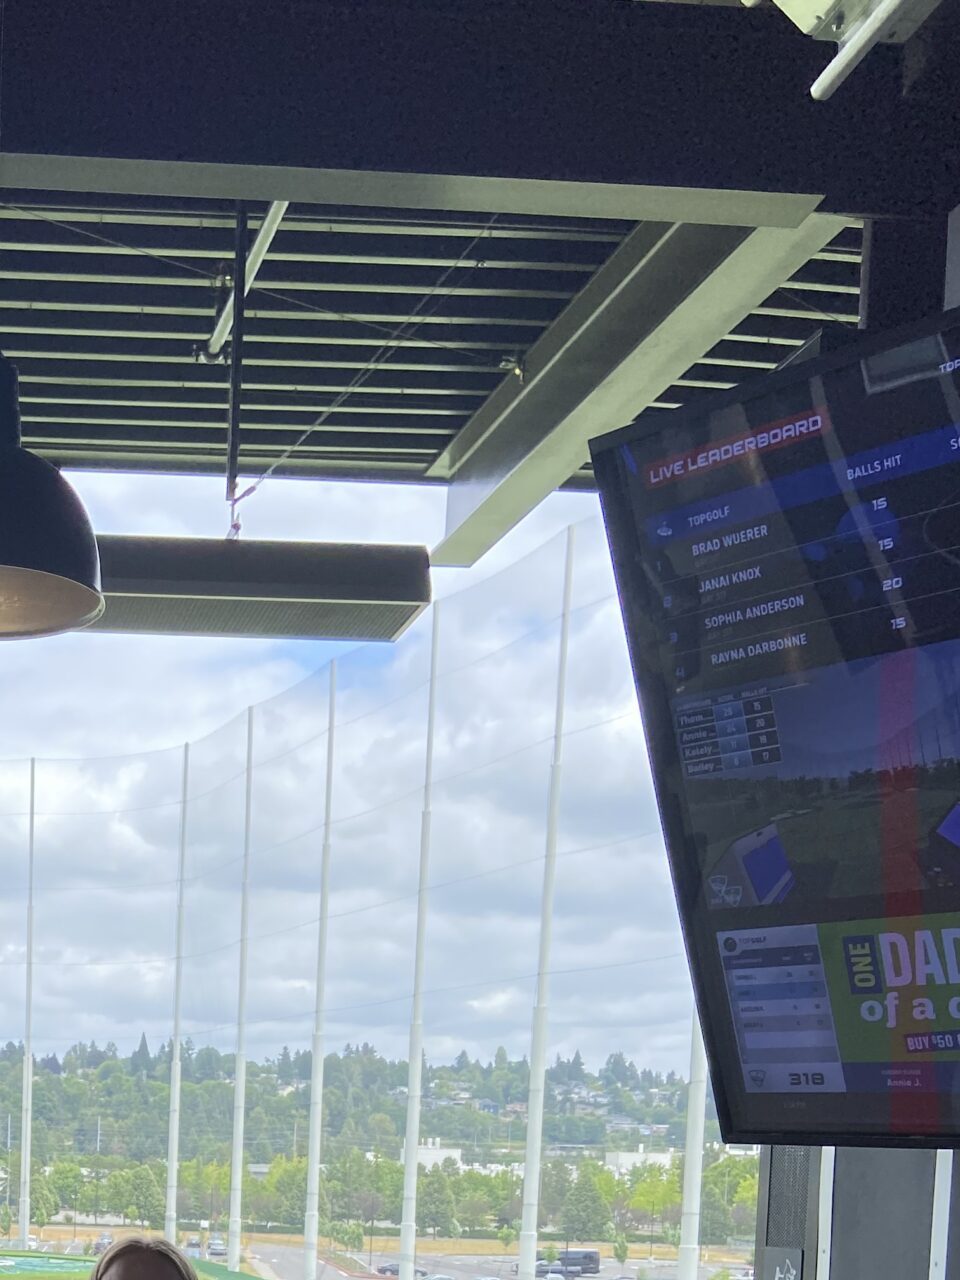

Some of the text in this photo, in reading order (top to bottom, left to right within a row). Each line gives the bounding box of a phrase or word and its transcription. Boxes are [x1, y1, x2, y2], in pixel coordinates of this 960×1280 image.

[650, 415, 822, 484] LIVE LEADERBOARD
[846, 454, 902, 480] BALLS HIT
[688, 505, 730, 528] TOPGOLF
[872, 497, 888, 511] 15
[692, 538, 721, 556] BRAD
[722, 524, 768, 548] WUERER
[878, 537, 894, 551] 15
[698, 575, 730, 593] JANAI
[732, 565, 762, 584] KNOX
[882, 577, 903, 592] 20
[704, 610, 744, 629] SOPHIA
[746, 594, 805, 619] ANDERSON
[890, 616, 907, 631] 15
[711, 648, 746, 665] RAYNA
[748, 633, 808, 657] DARBONNE
[848, 942, 876, 988] ONE
[860, 991, 899, 1028] of
[912, 998, 936, 1020] a
[906, 1035, 930, 1051] BUY
[931, 1033, 953, 1049] $50
[789, 1071, 825, 1087] 318
